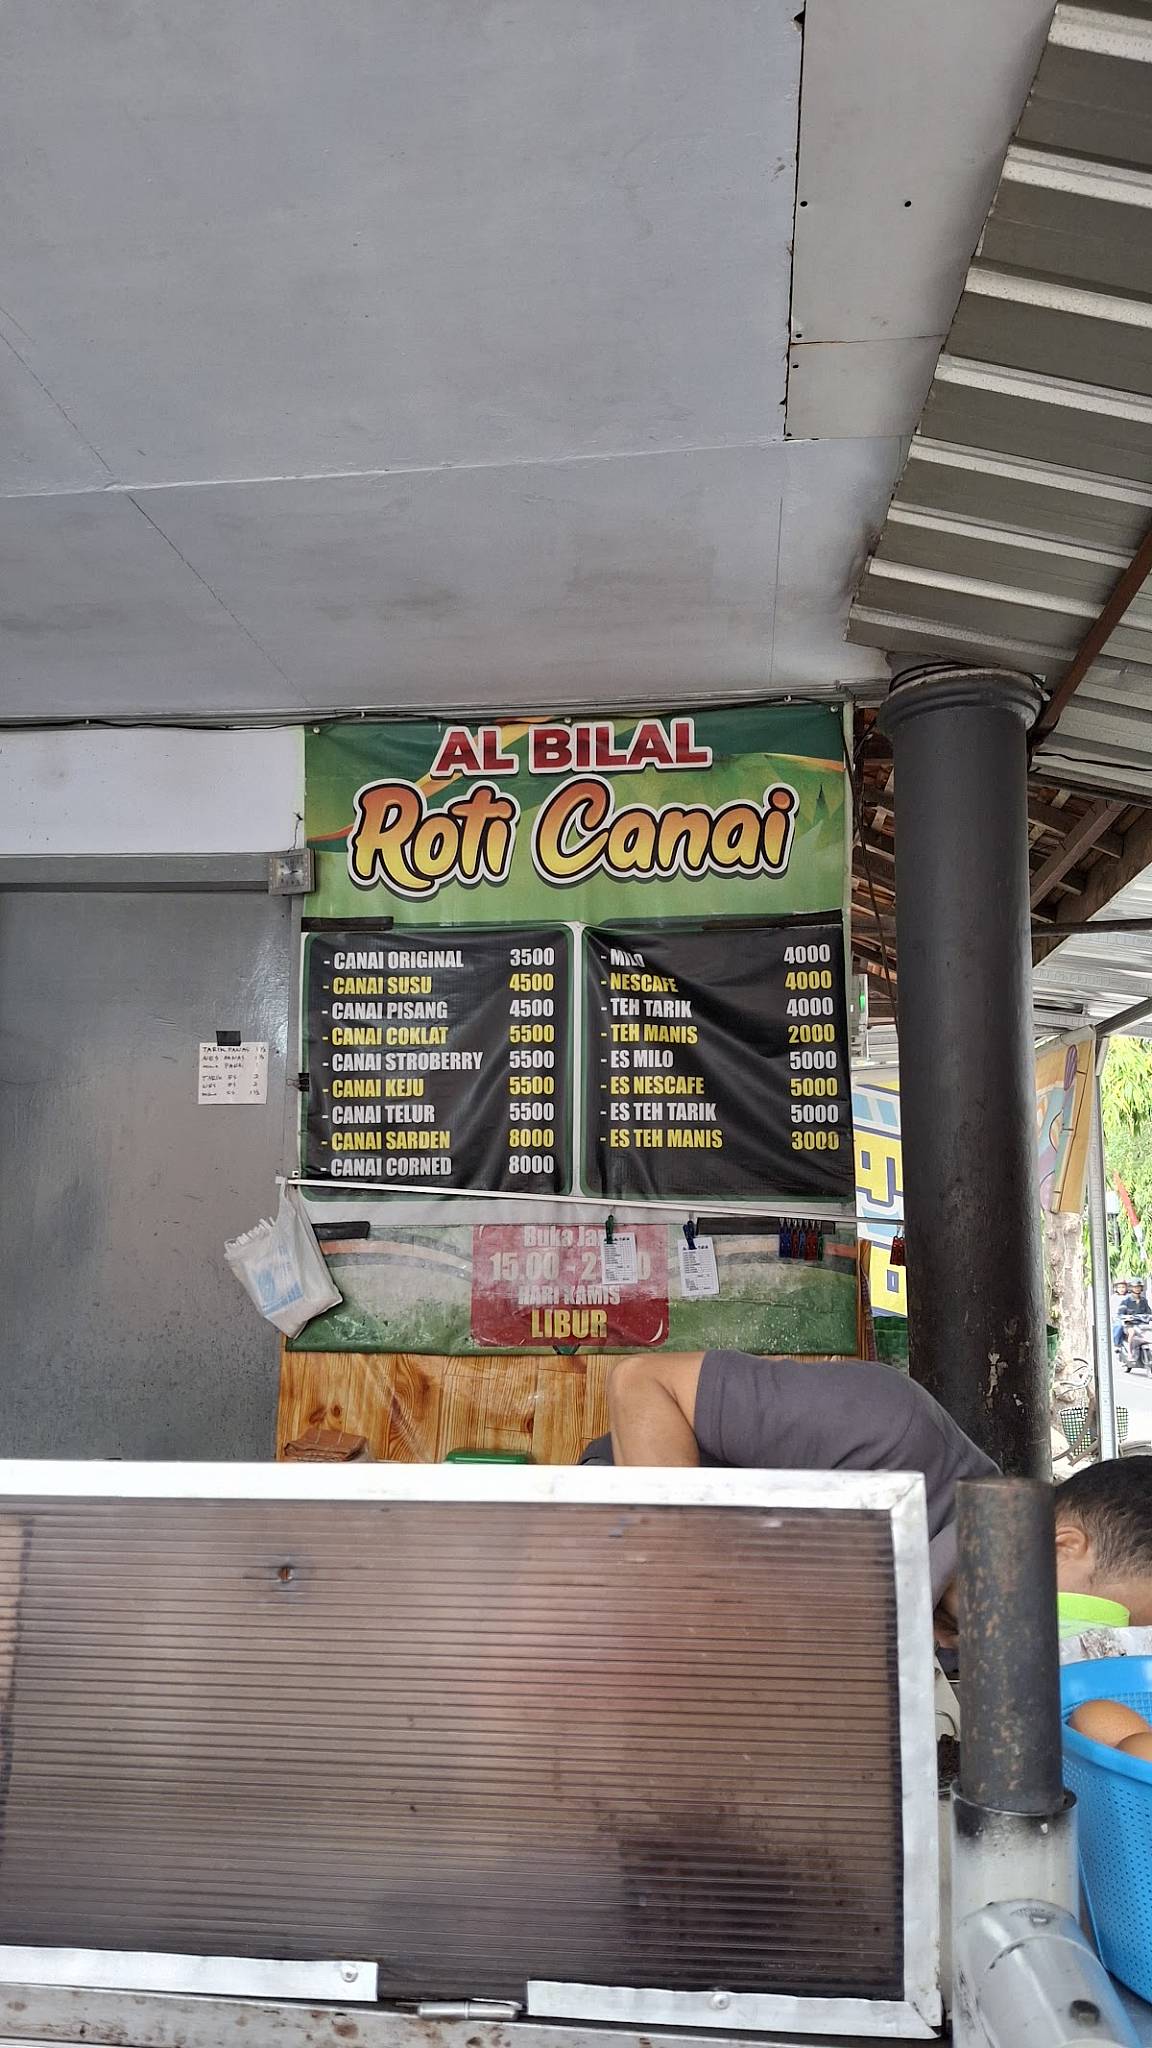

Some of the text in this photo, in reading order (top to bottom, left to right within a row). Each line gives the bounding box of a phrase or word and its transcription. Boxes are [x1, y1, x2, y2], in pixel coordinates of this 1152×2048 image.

[431, 720, 711, 774] AL BILAL
[349, 776, 799, 895] Roti Canai
[333, 947, 555, 969] CANAI ORIGINAL 3500
[610, 944, 831, 967] MILO 4000
[332, 973, 554, 994] CANAI SUSU 4500
[609, 970, 832, 992] NESCAFE 4000
[331, 998, 554, 1020] CANAI PISANG 4500
[609, 996, 834, 1017] TEH TARIK 4000
[331, 1024, 555, 1045] CANAI COKLAT 5500
[610, 1023, 835, 1044] TEH MANIS 2000
[332, 1049, 555, 1071] CANAI STROBERRY 5500
[610, 1049, 837, 1069] ES MILO 5000
[332, 1075, 555, 1098] CANAI KEJU 5500
[610, 1075, 838, 1096] ES NESCAFE 5000
[332, 1102, 555, 1124] CANAI TELUR 5500
[610, 1102, 839, 1123] ES TEH TARIK 5000
[331, 1128, 554, 1151] CANAI SARDEN 8000
[610, 1128, 840, 1149] ES TEH MANIS 3000
[330, 1154, 554, 1176] CANAI CORNED 8000
[524, 1226, 573, 1247] Buka
[531, 1309, 608, 1338] LIBUR
